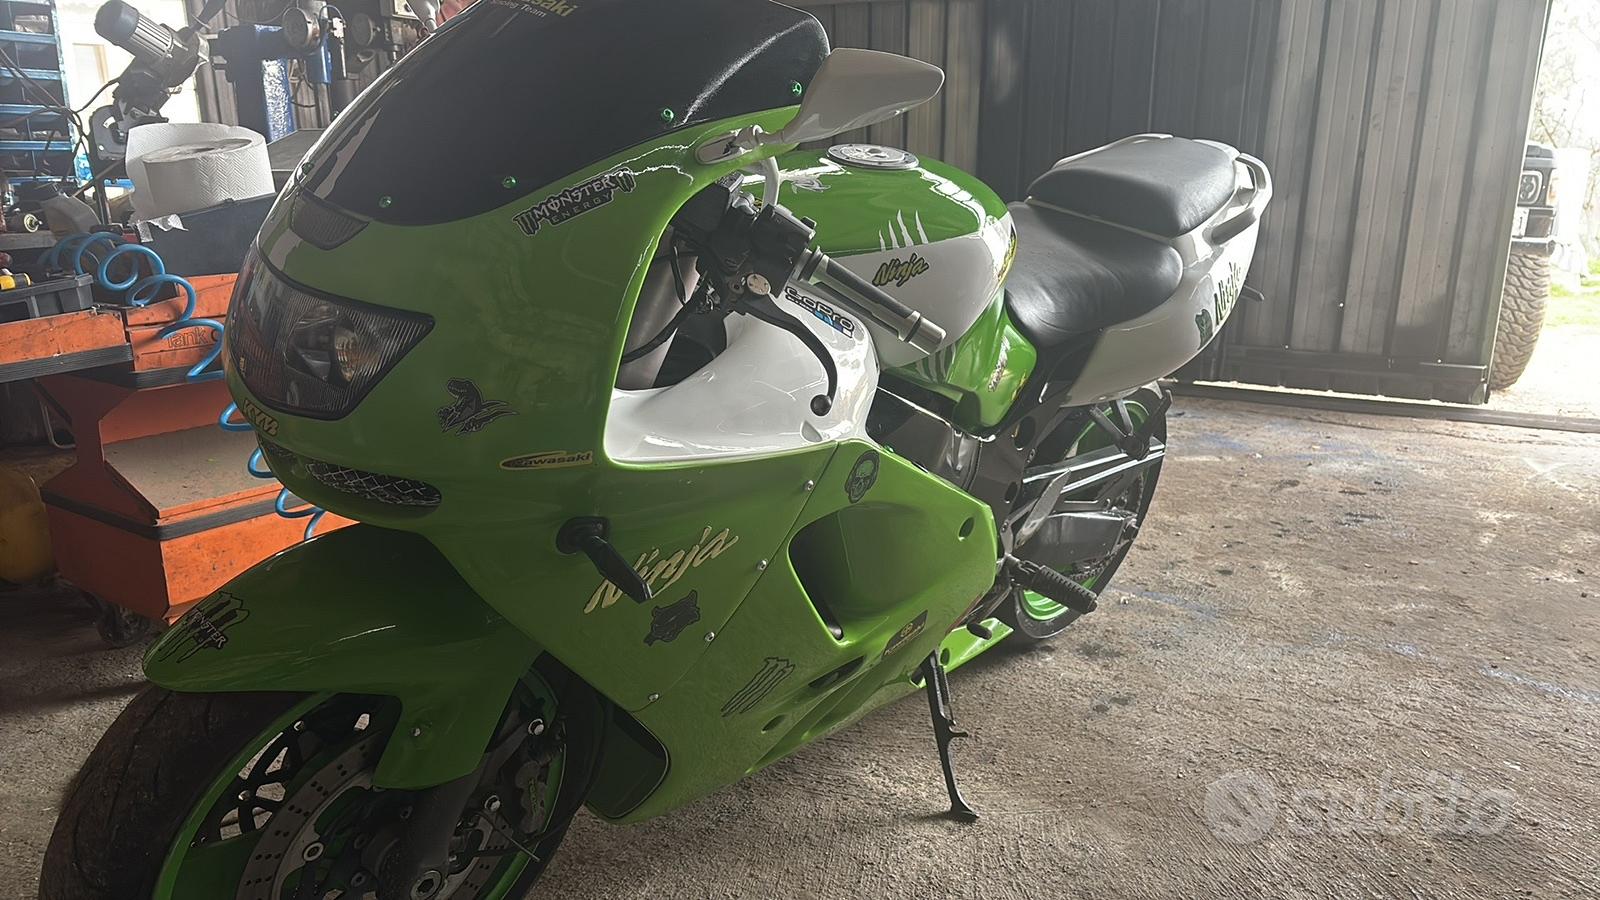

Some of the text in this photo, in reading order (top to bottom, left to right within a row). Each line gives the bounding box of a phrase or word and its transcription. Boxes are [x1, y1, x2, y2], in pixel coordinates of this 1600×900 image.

[520, 3, 547, 17] Team
[534, 176, 616, 219] MONSTER
[551, 192, 611, 223] ENERGY
[872, 252, 930, 287] Ninja
[785, 286, 855, 331] GoPro
[511, 453, 590, 467] Kawasaki
